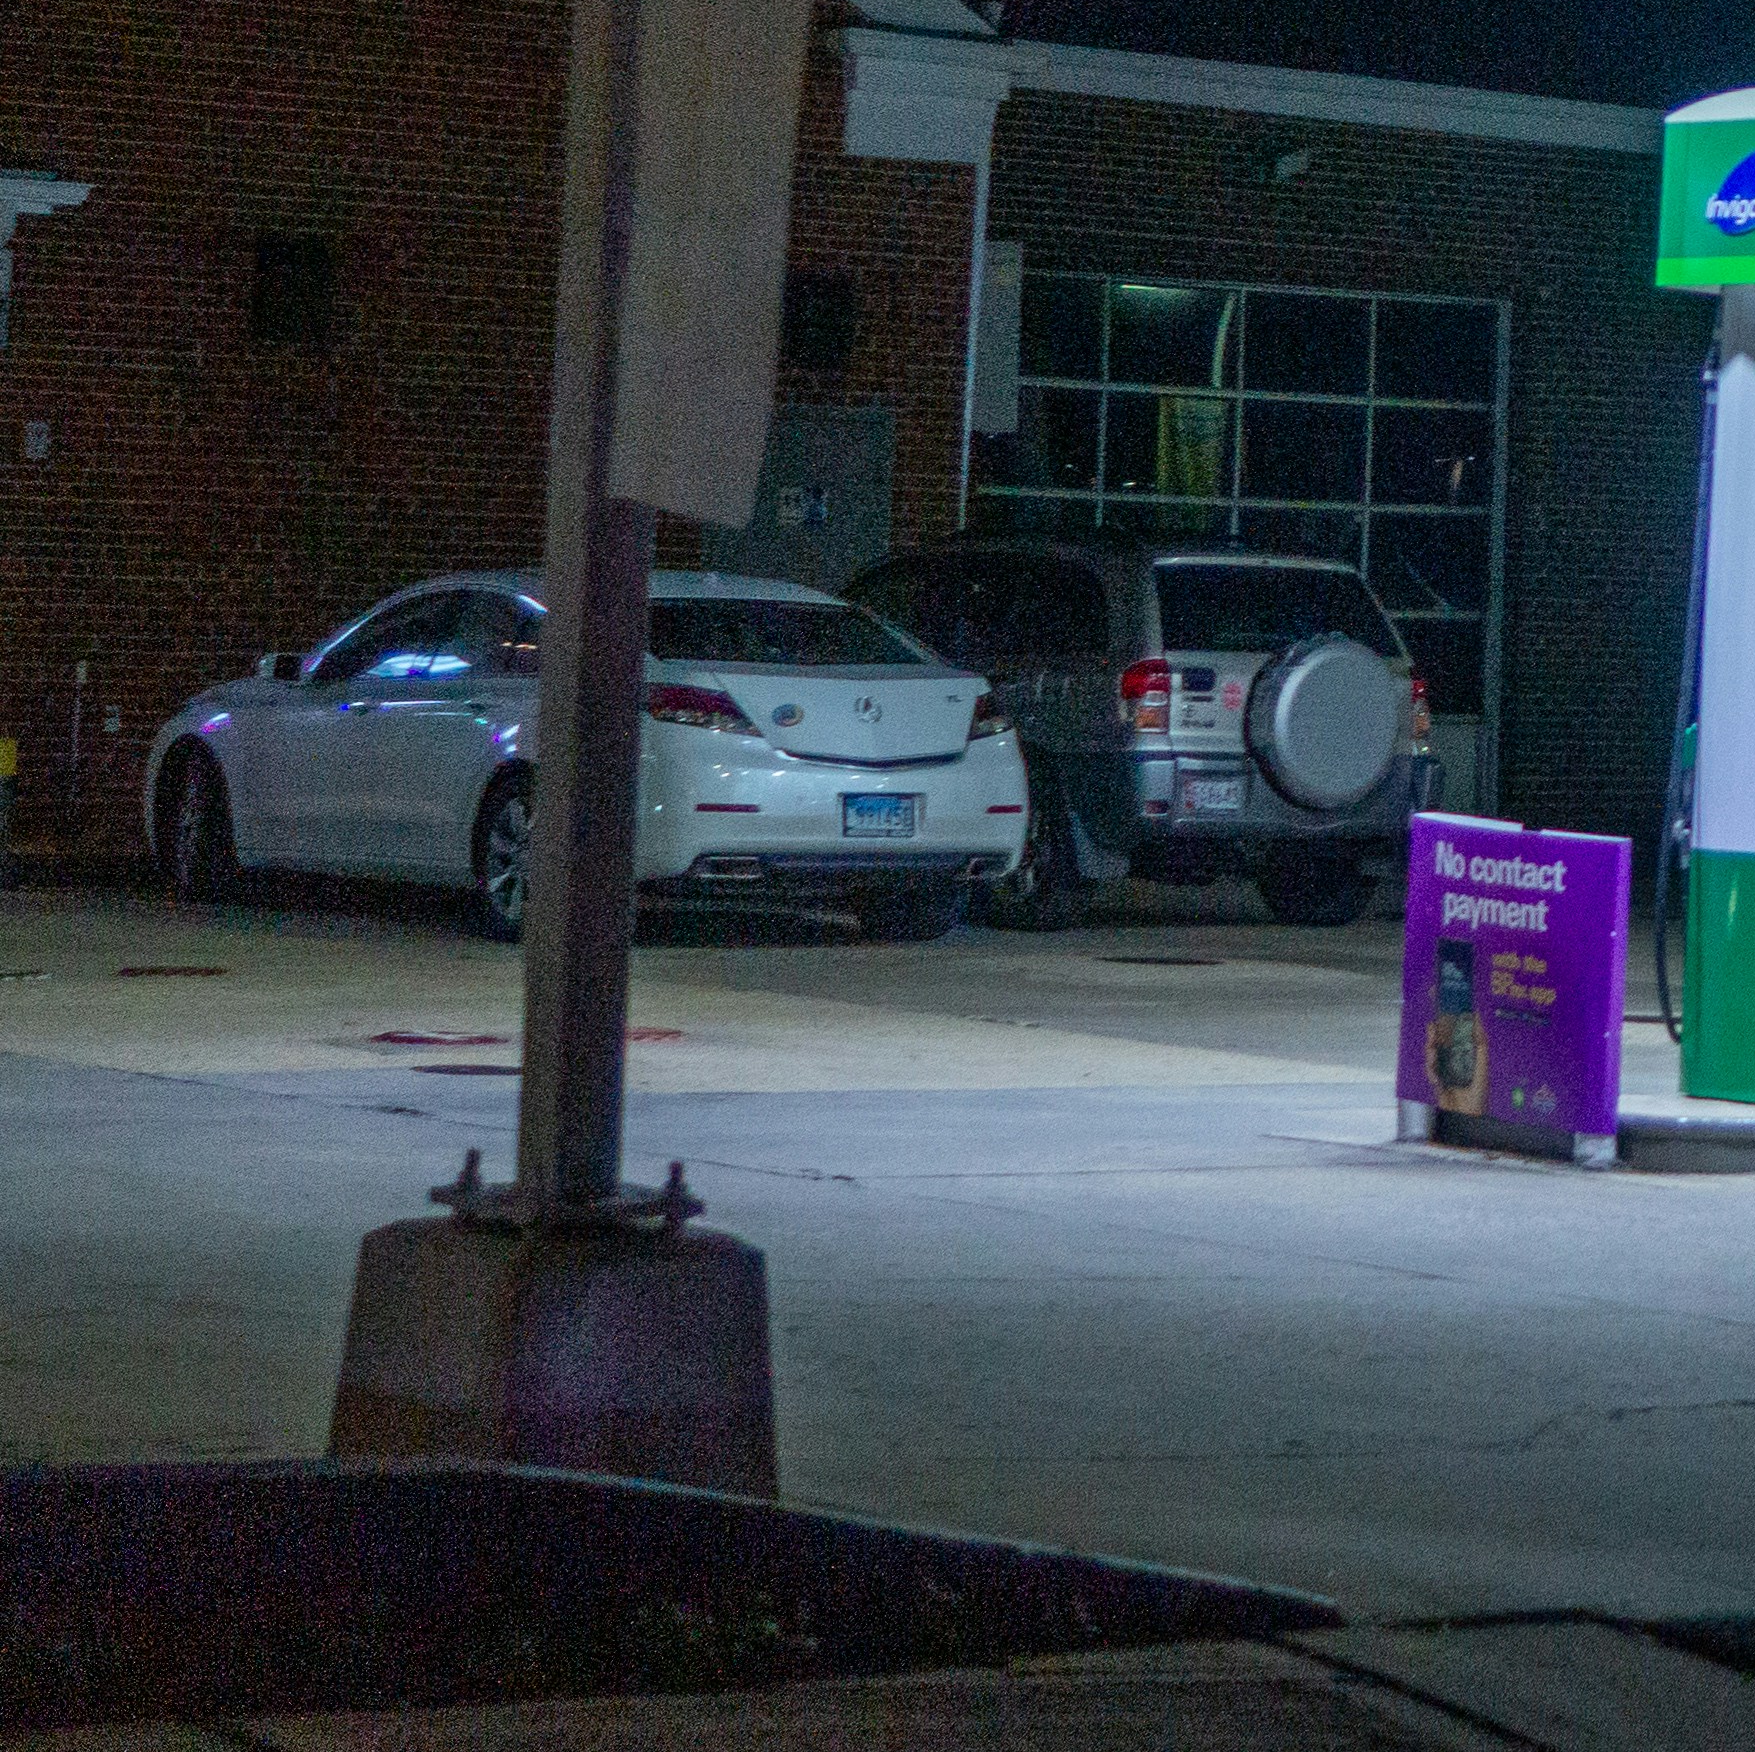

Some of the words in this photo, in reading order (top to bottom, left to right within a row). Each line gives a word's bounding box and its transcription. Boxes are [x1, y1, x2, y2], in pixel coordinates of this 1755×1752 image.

[1434, 840, 1466, 880] No
[1469, 855, 1568, 893] contact
[1442, 891, 1549, 932] payment
